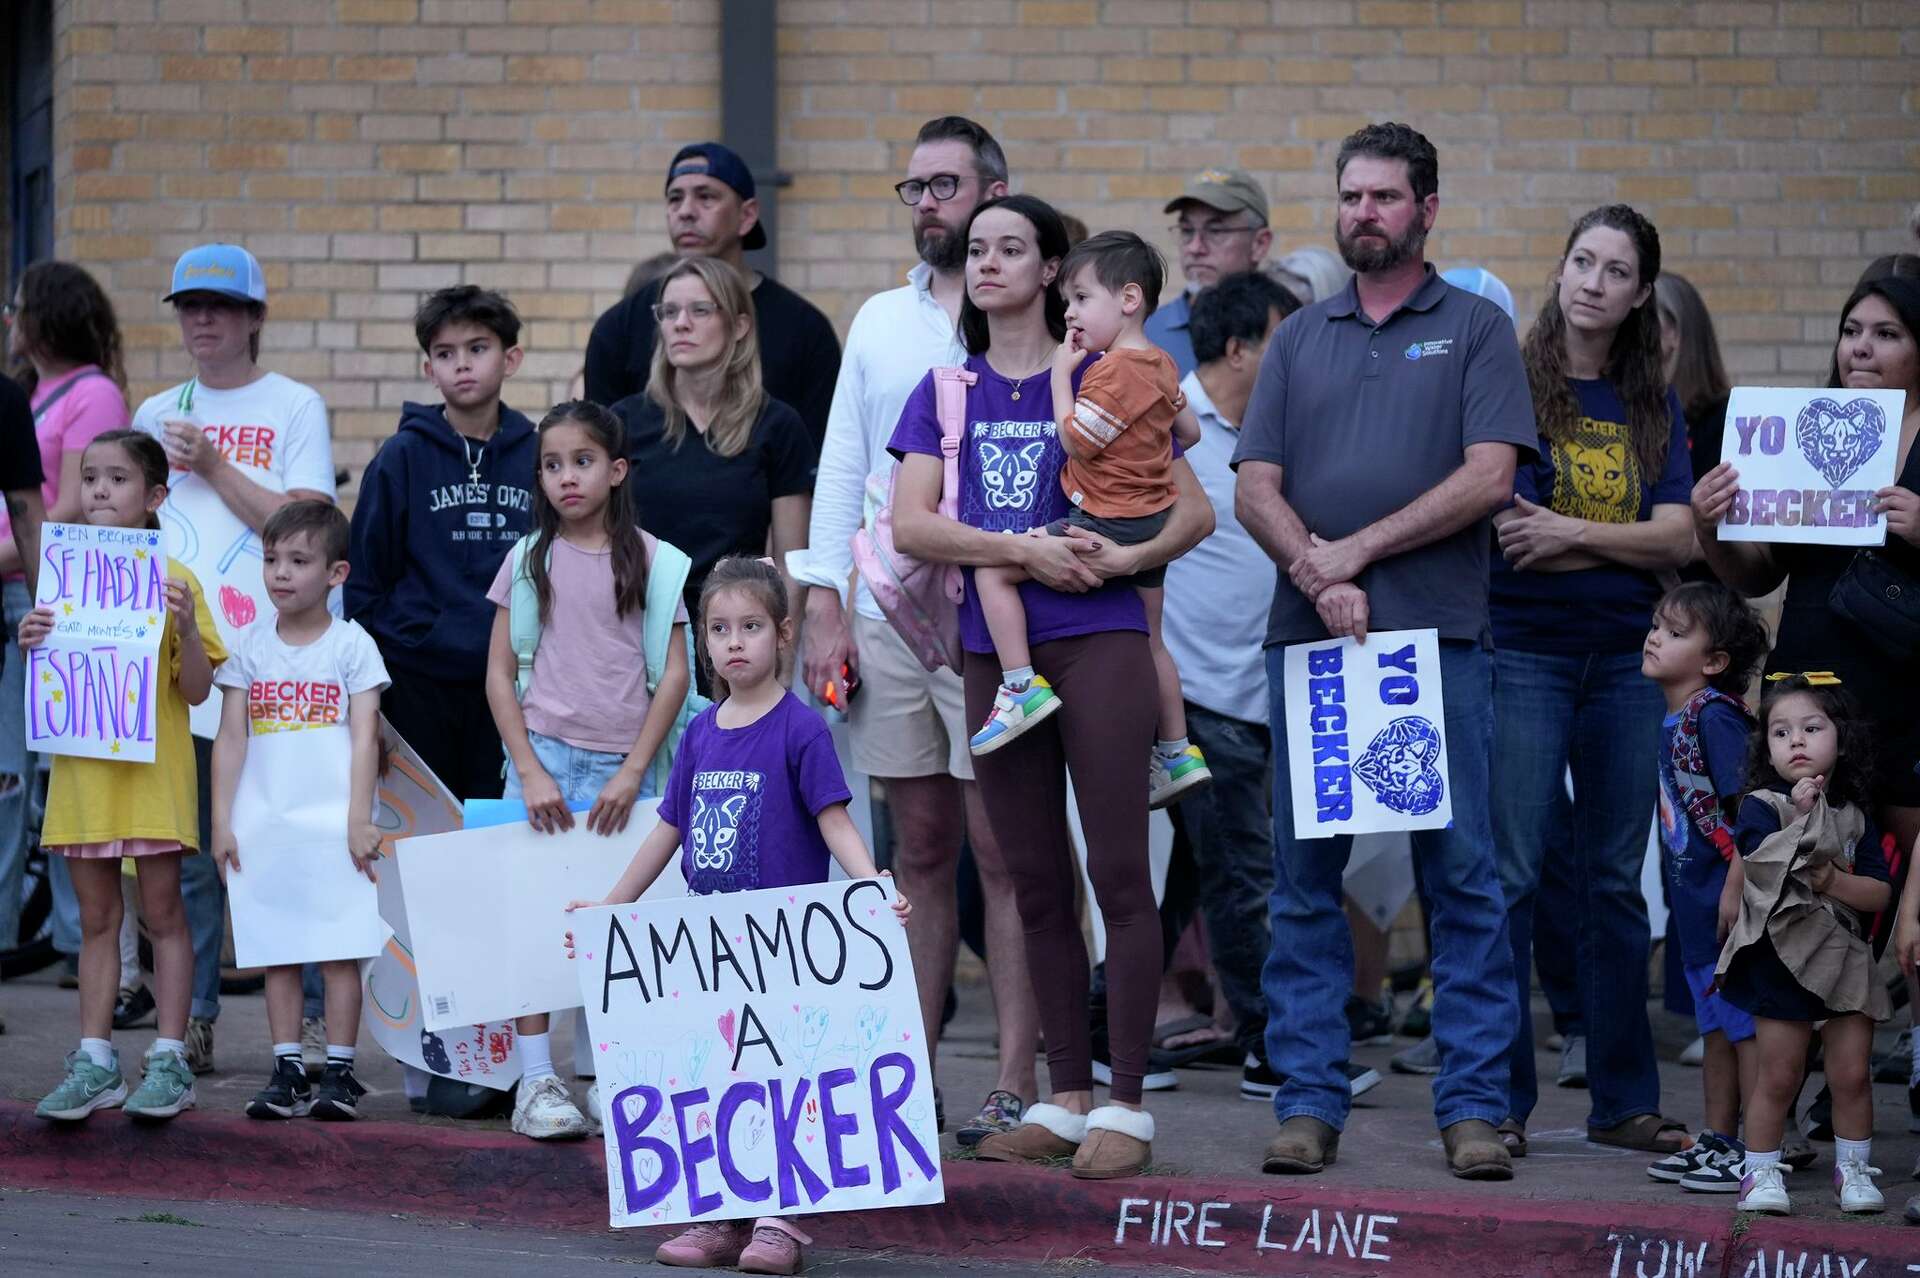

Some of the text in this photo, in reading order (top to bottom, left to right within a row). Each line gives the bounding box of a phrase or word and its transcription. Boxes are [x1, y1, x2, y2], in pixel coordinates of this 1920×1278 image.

[201, 424, 276, 449] CKER
[990, 422, 1040, 437] BECKER
[1735, 415, 1786, 456] YO
[430, 483, 532, 512] JAMESOWN
[1725, 488, 1879, 528] BECKER
[68, 529, 144, 545] EN BECKER
[984, 512, 1033, 530] KINDER
[40, 543, 163, 612] SE HABLA
[30, 646, 152, 742] ESPAÑOL
[250, 680, 341, 706] BECKER
[1378, 644, 1419, 705] YO
[250, 701, 340, 724] BECKER
[1308, 646, 1353, 823] BECKER
[697, 771, 741, 789] BECKER
[602, 880, 894, 1013] AMAMOS
[731, 1003, 783, 1071] A
[611, 1052, 938, 1217] BECKER
[1113, 1198, 1398, 1262] FIRE LANE
[1608, 1232, 1869, 1278] TOW AWAY
